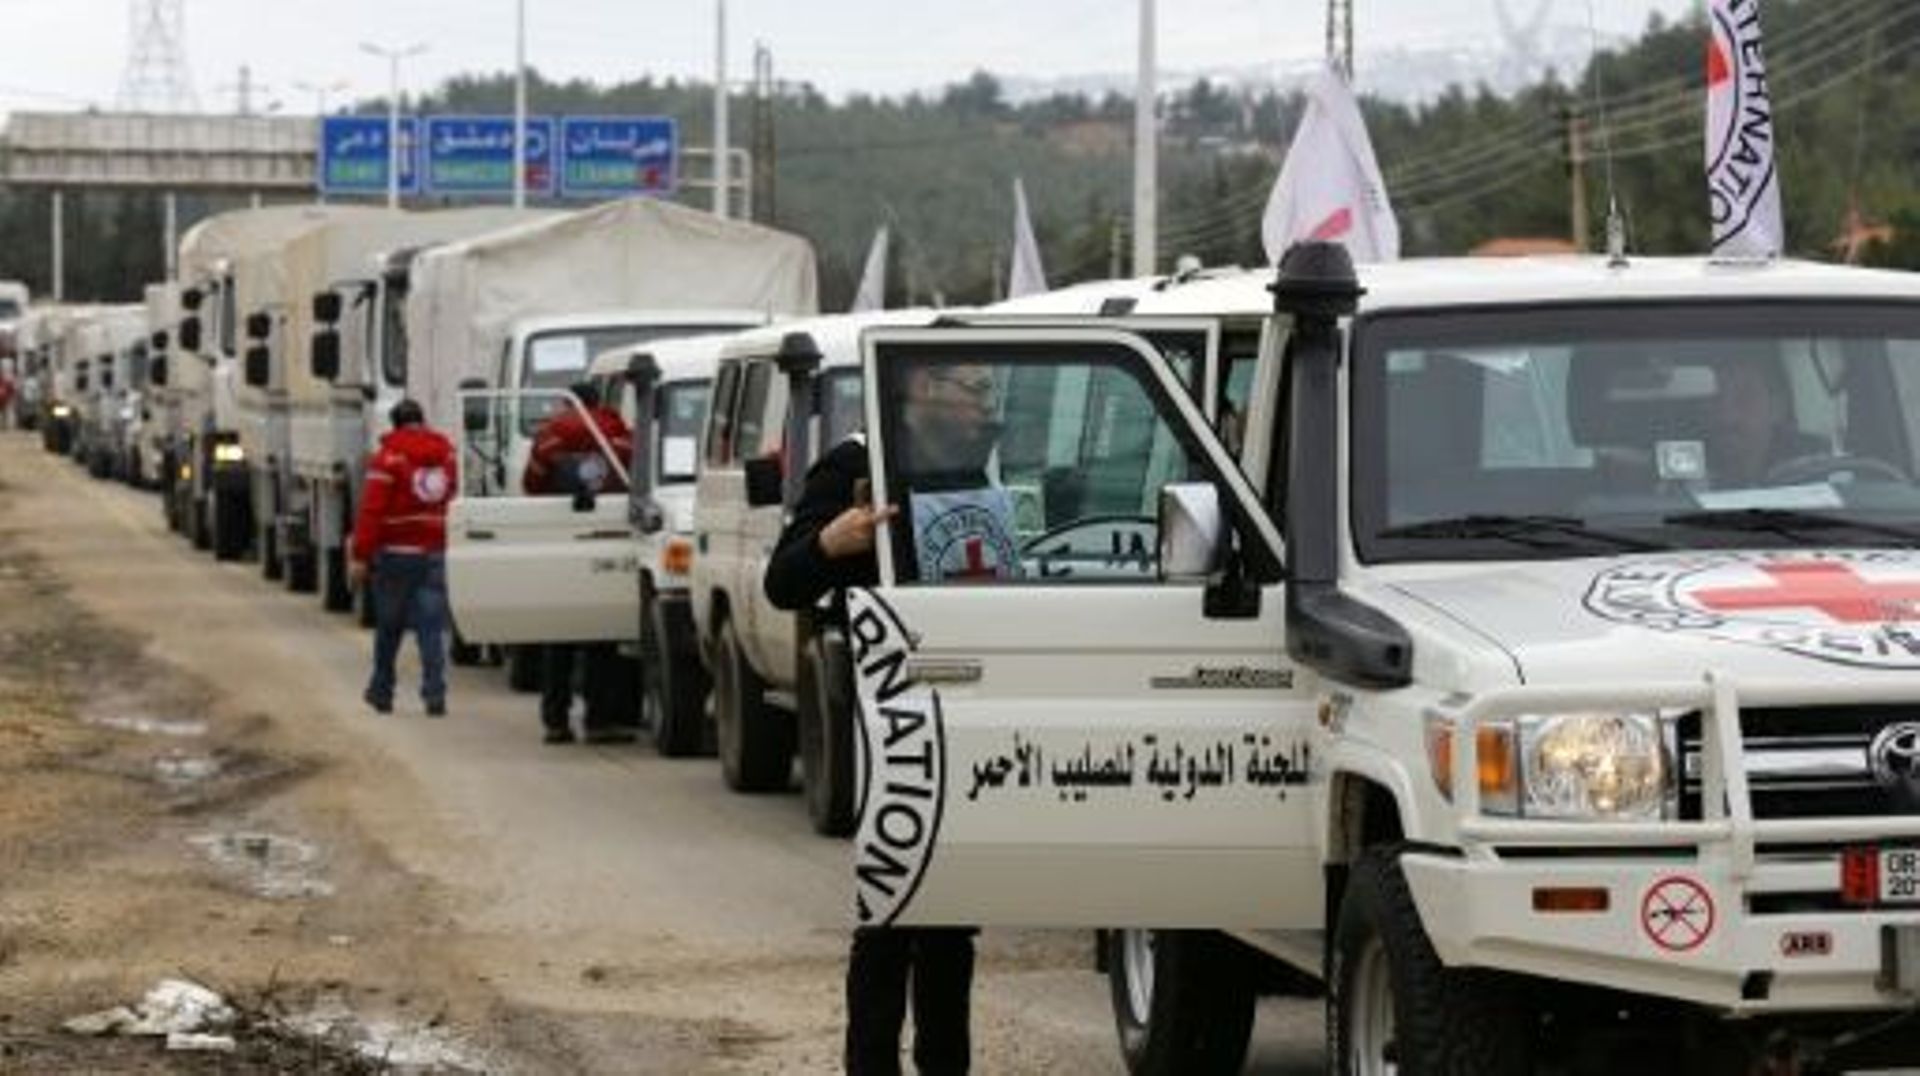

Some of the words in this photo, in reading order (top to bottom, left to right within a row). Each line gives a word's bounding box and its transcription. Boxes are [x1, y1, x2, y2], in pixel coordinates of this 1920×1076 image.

[1709, 0, 1769, 224] TERNATIO
[851, 594, 934, 919] RNATION
[968, 729, 1042, 801] الأحمر
[1052, 740, 1134, 801] للصليب
[1142, 736, 1233, 802] الدولية
[1243, 733, 1316, 802] للجنة
[1888, 876, 1920, 896] 20
